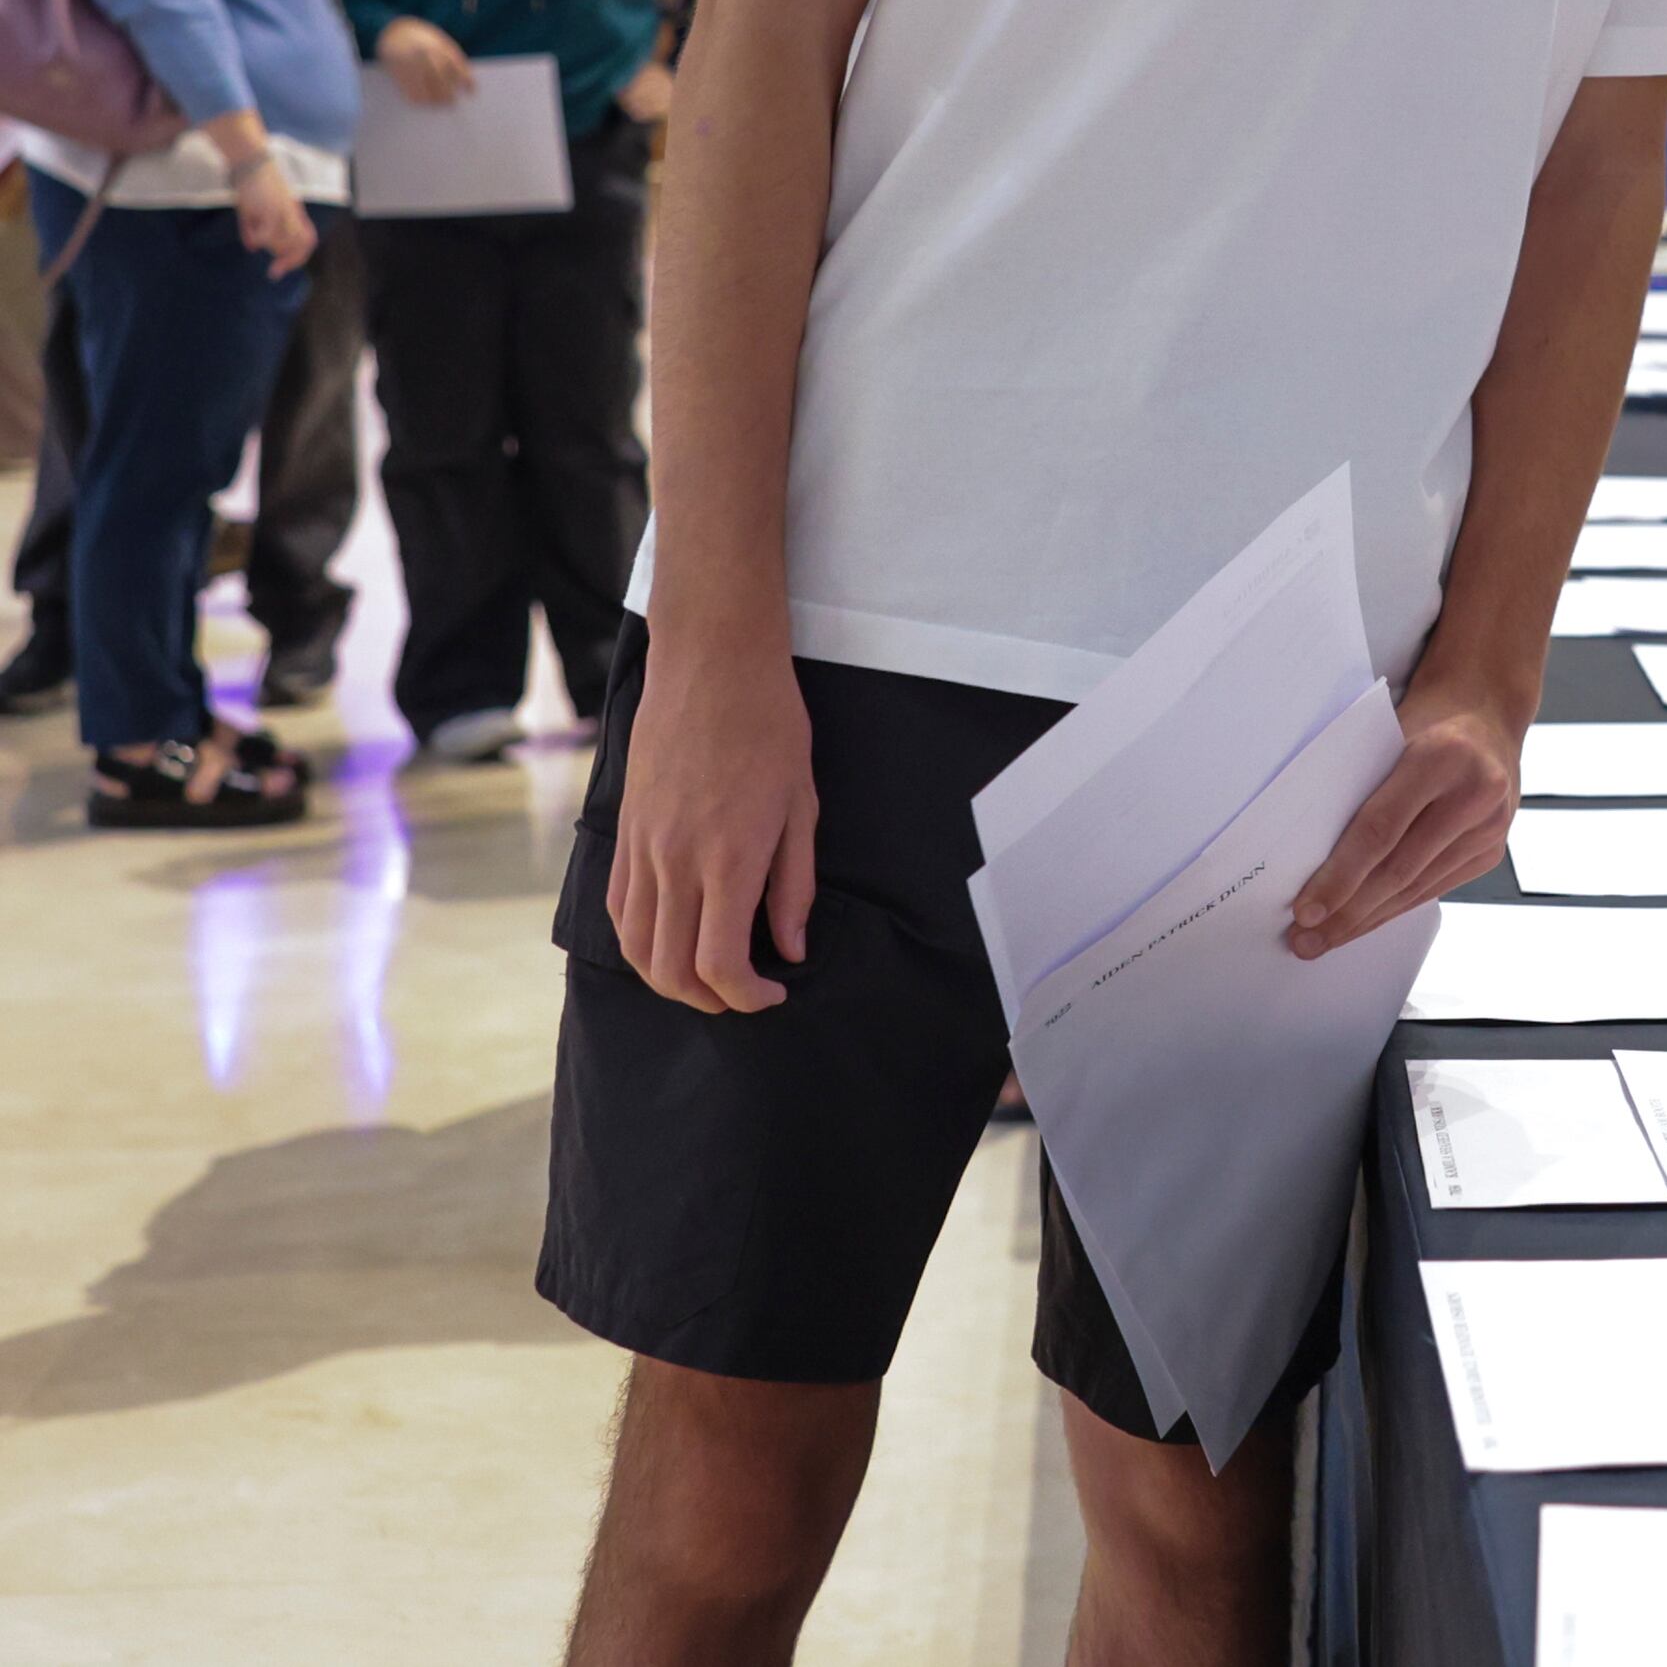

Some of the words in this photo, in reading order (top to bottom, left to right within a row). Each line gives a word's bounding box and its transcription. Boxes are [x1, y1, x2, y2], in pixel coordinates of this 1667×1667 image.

[1092, 949, 1144, 990] AIDEN
[1149, 900, 1216, 950] PATRICK
[1220, 860, 1265, 902] DUNN
